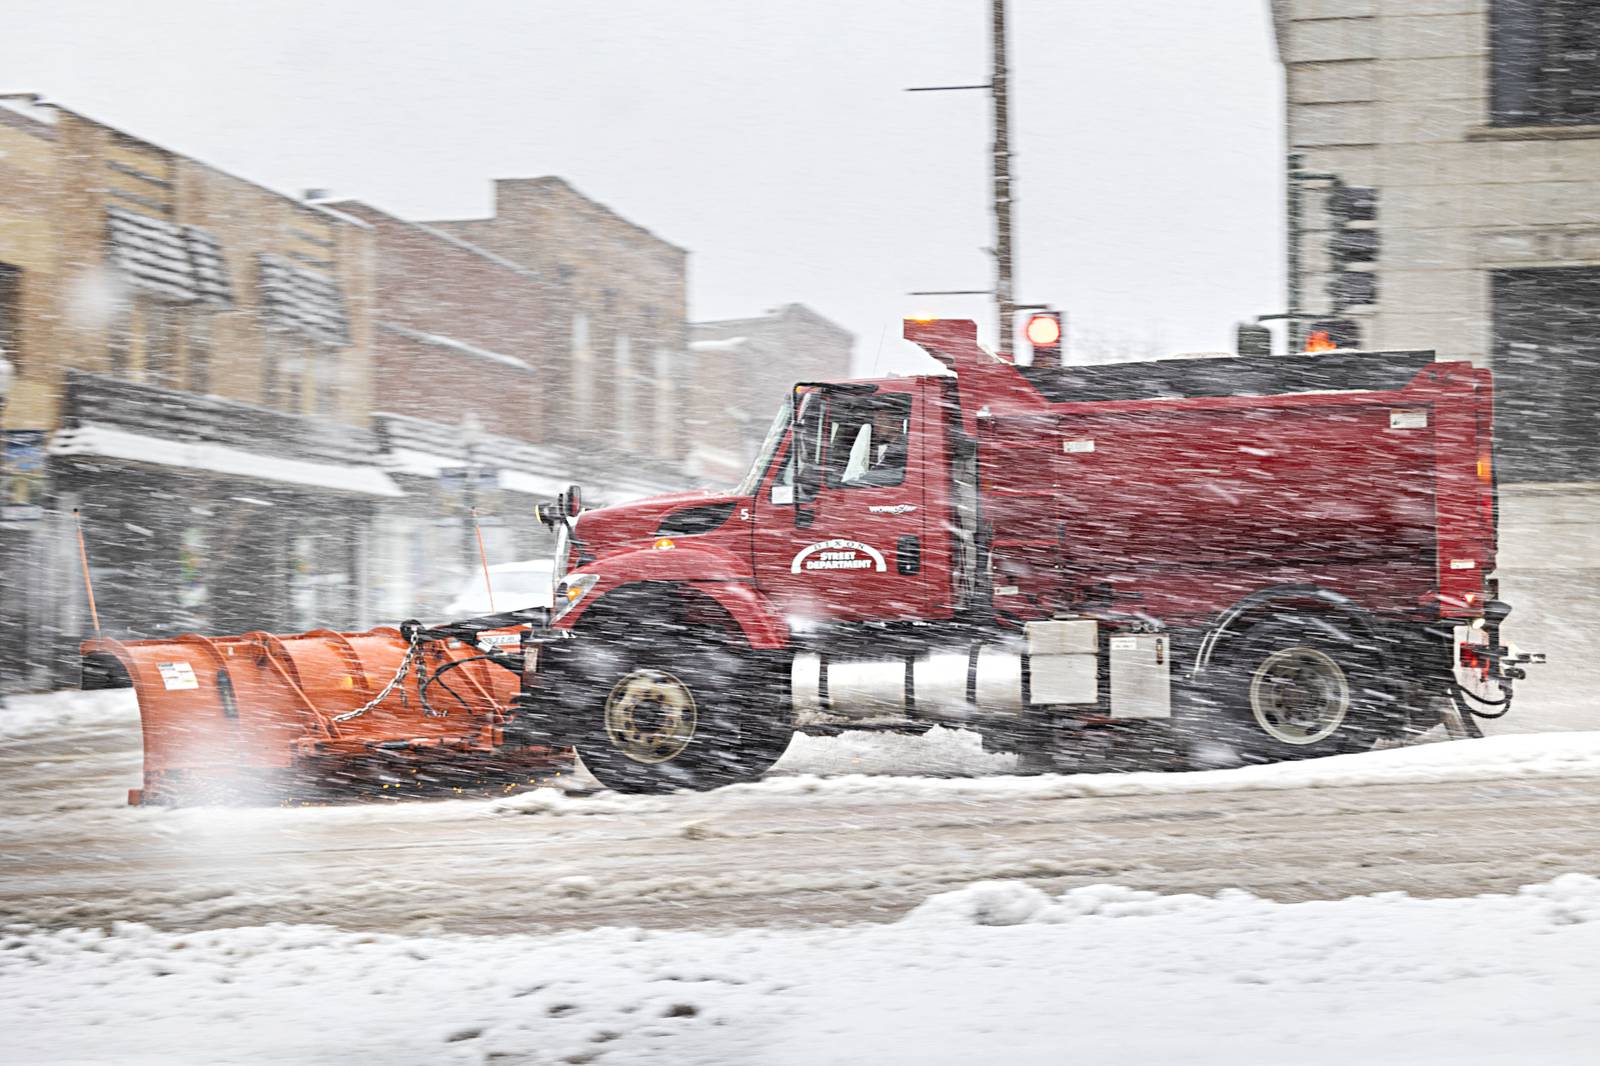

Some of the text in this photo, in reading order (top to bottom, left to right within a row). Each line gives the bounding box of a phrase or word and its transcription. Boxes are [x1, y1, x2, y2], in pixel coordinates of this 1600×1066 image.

[741, 508, 749, 520] 5
[813, 541, 865, 550] DIXON
[820, 551, 856, 561] STREET
[806, 560, 872, 570] DEPARTMENT
